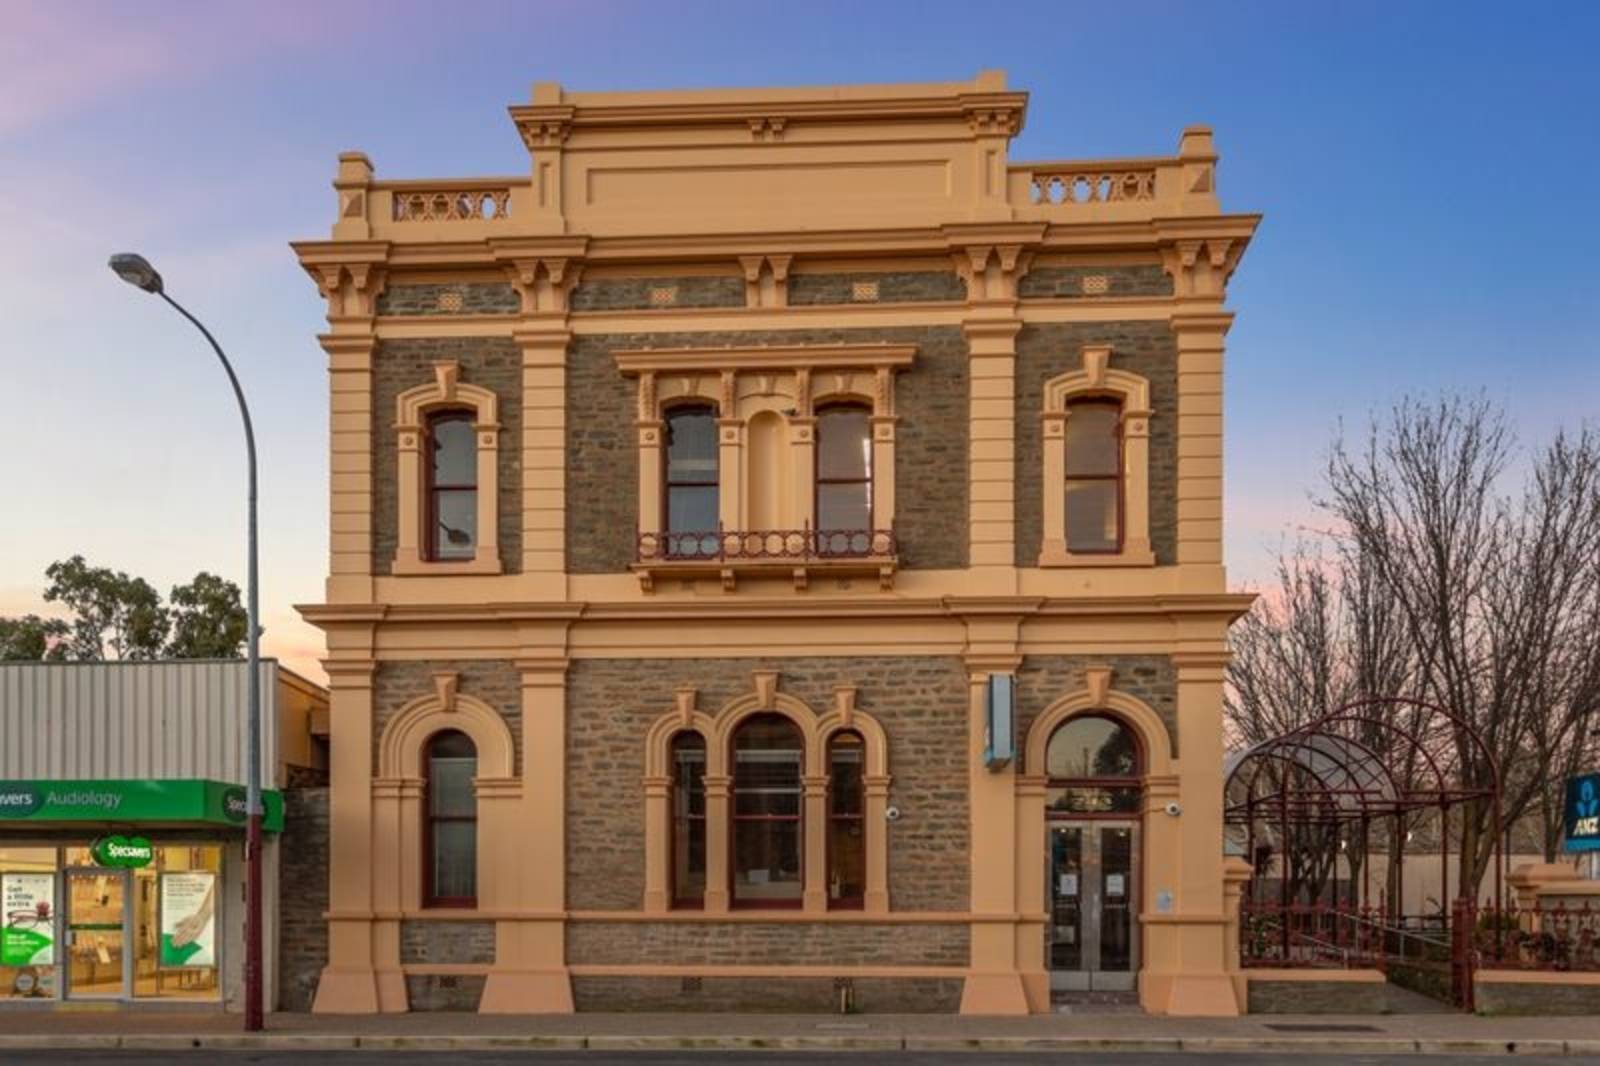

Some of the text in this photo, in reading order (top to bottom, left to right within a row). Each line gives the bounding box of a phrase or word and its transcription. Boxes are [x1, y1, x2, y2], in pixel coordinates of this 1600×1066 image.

[0, 791, 122, 808] vers Audiology
[1573, 817, 1599, 835] ANZ
[108, 843, 151, 859] Specsavers
